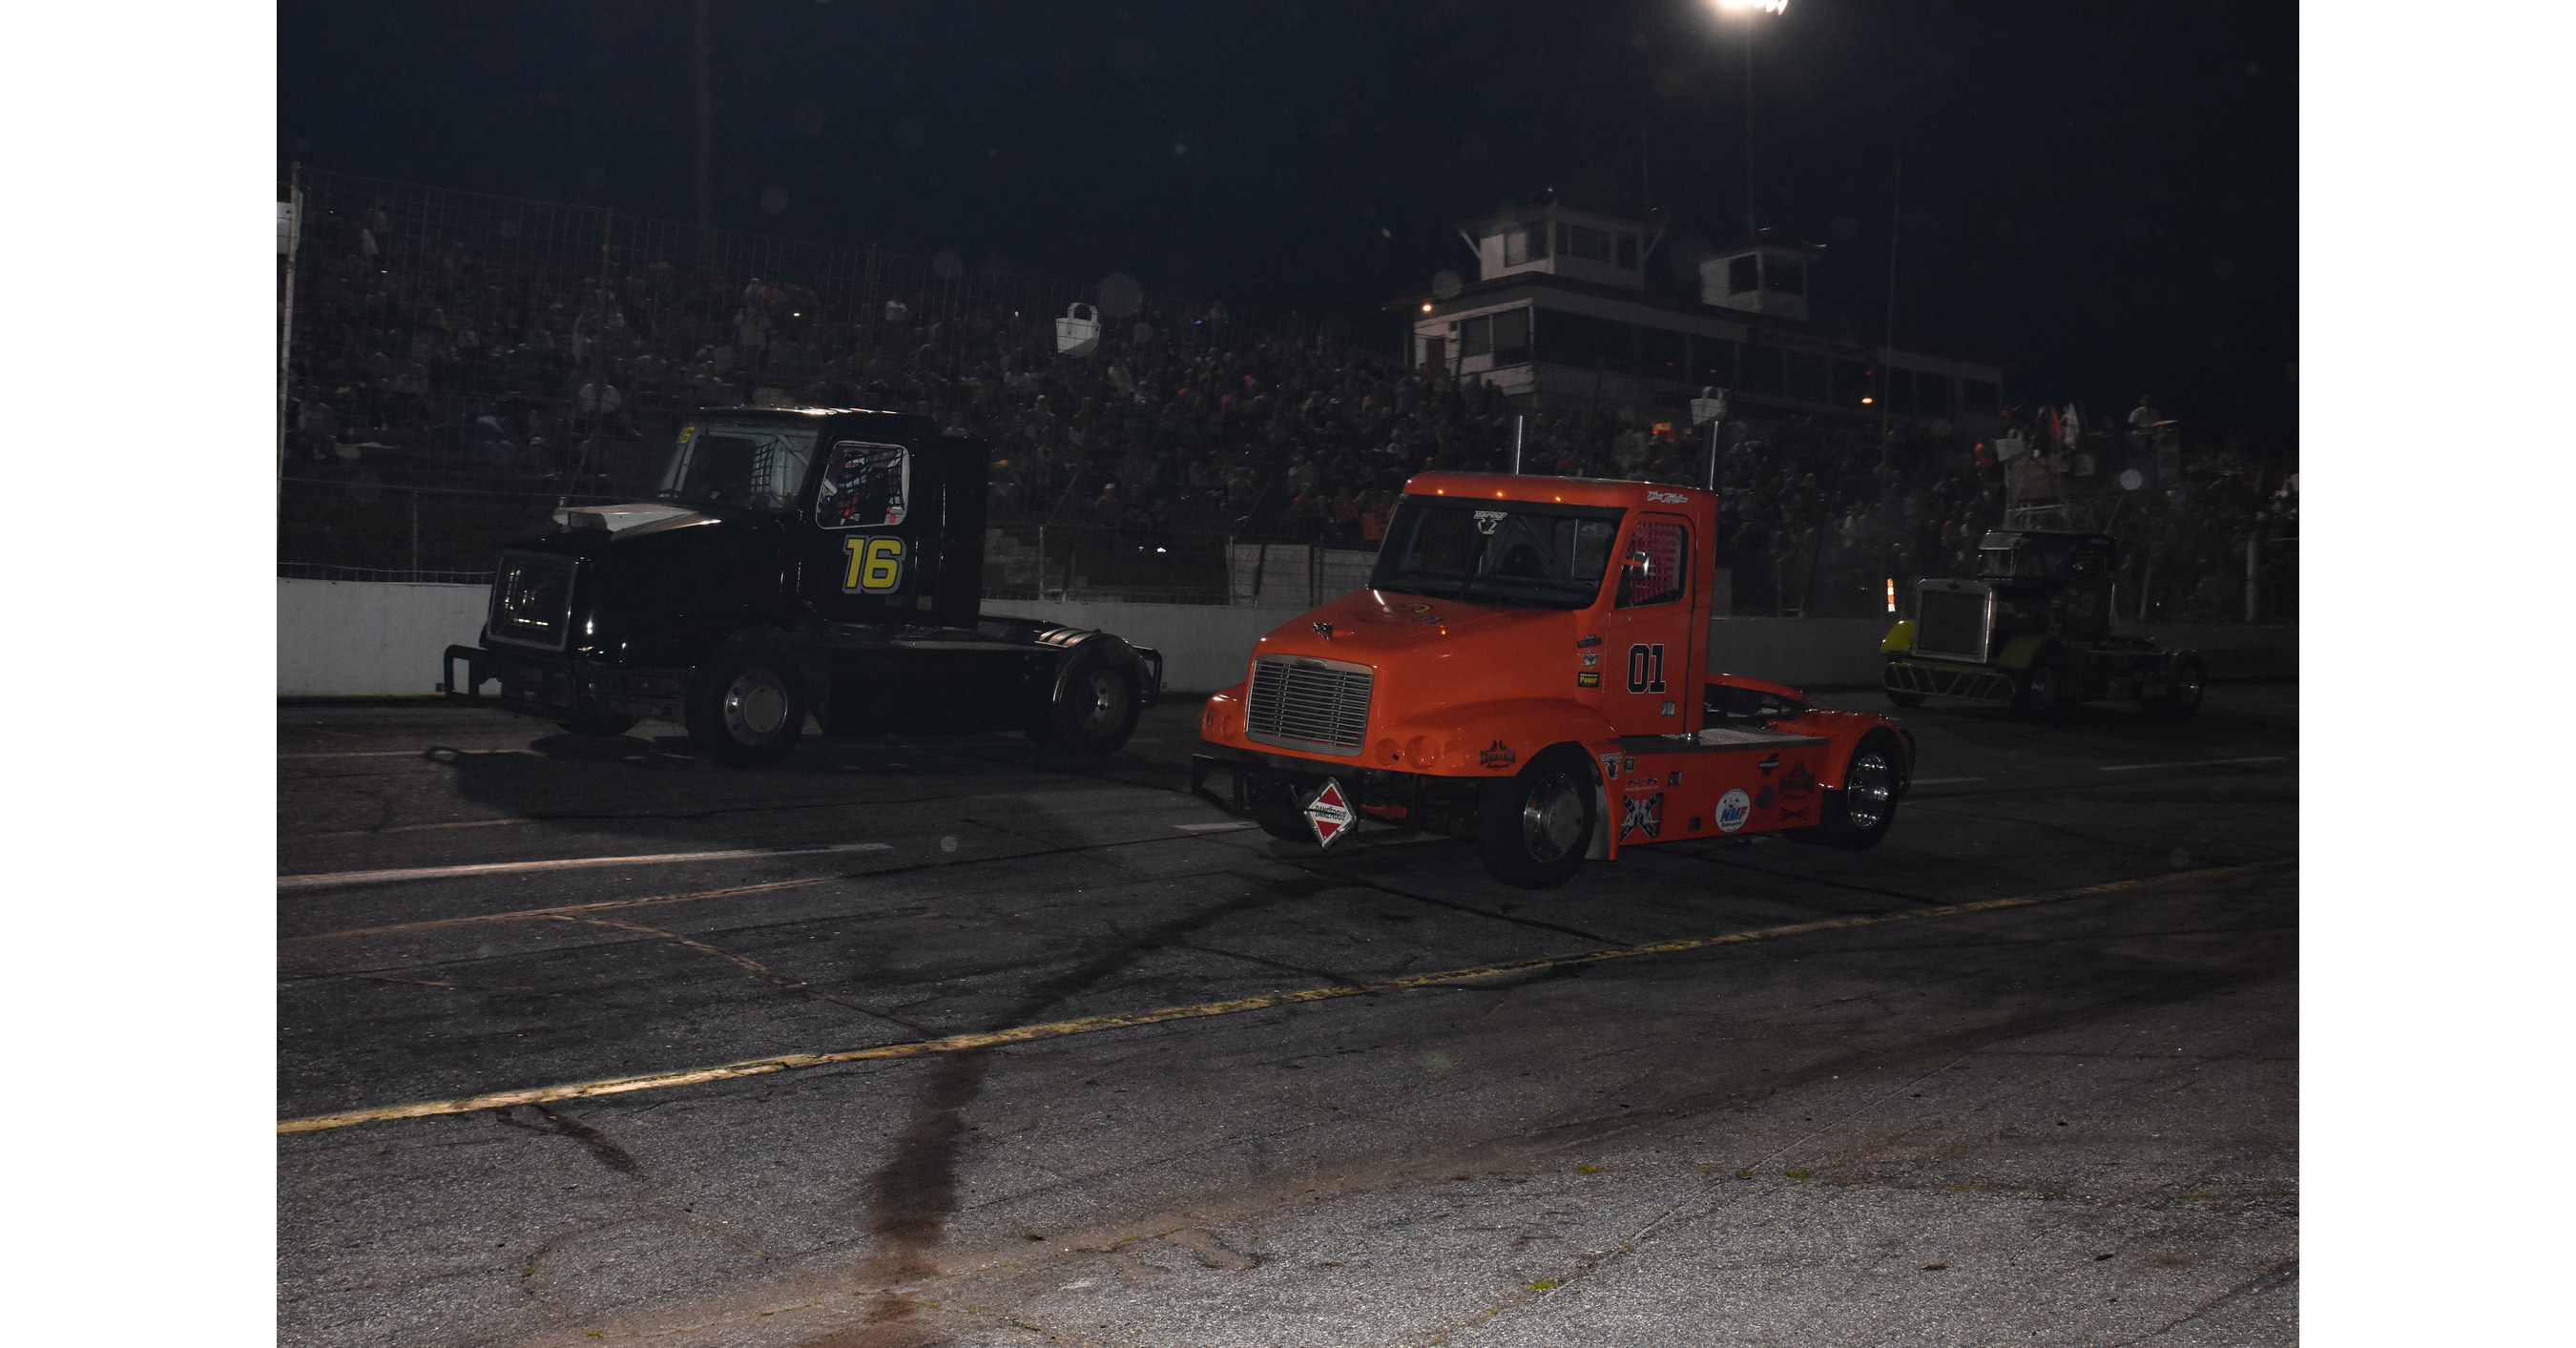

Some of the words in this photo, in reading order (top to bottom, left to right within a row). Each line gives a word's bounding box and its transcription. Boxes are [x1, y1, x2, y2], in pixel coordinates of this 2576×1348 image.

[842, 534, 906, 594] 16
[1627, 644, 1667, 695] 01
[1315, 805, 1347, 821] DANGEROUS
[1720, 806, 1749, 823] NMF
